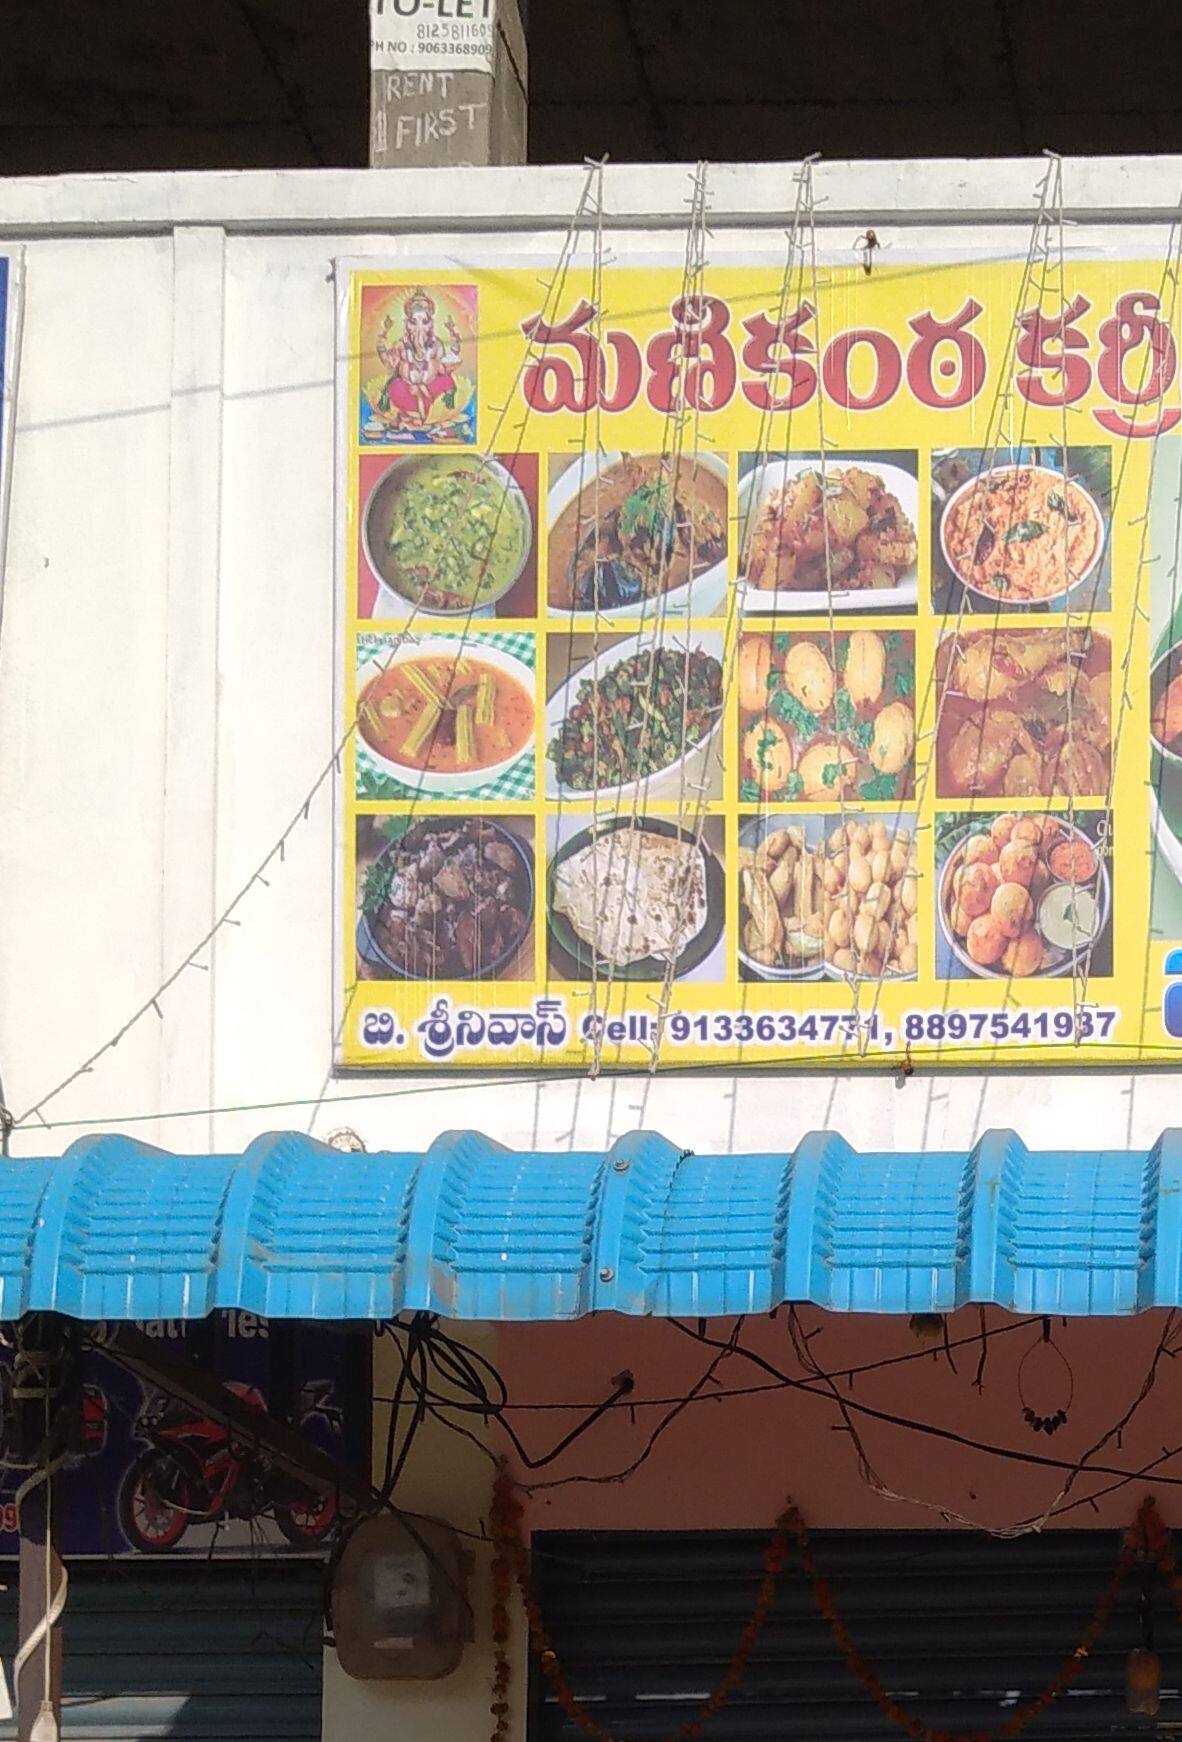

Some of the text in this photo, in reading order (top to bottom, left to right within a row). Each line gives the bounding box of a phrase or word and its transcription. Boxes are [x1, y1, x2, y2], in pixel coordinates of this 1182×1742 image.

[387, 42, 407, 53] NO
[521, 295, 987, 413] మణికంఠ
[362, 1011, 405, 1046] బి.
[418, 999, 567, 1057] శ్రీనివాస్
